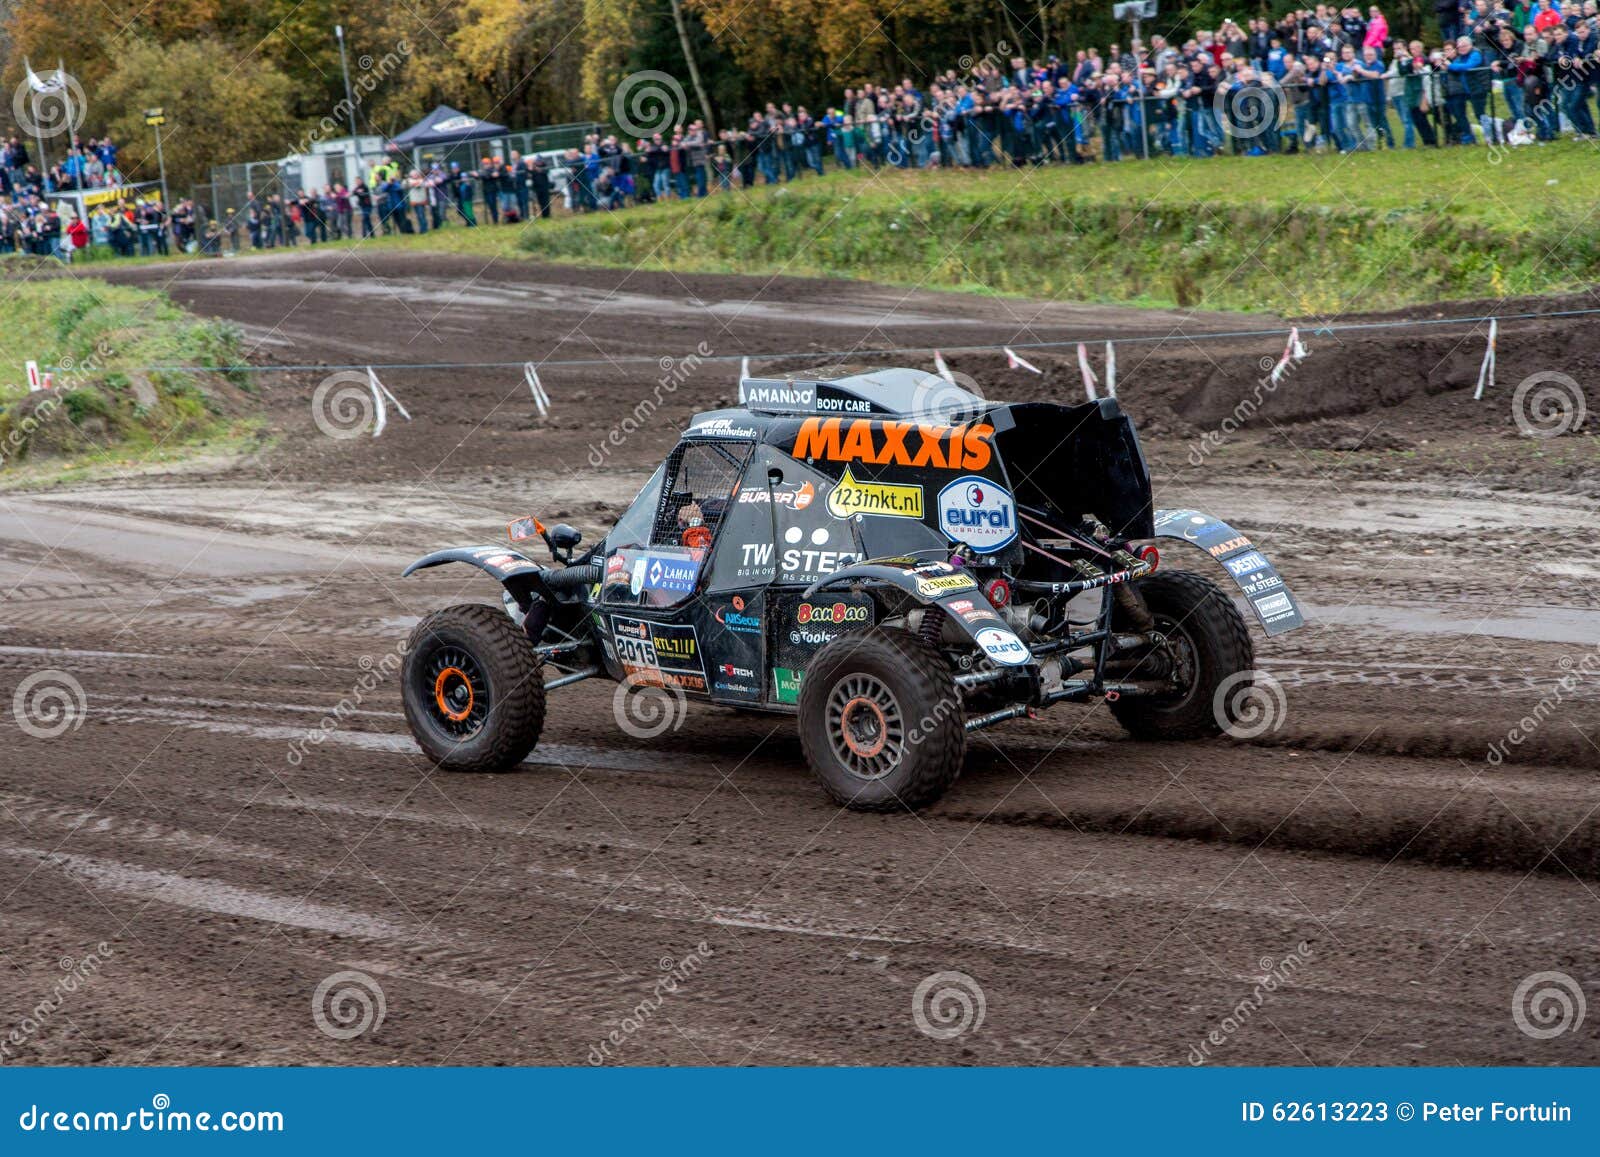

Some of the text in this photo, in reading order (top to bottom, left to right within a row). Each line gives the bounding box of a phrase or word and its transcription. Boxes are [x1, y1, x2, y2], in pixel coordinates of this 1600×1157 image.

[749, 388, 813, 404] AMANDO
[817, 398, 871, 412] BODY CARE
[792, 417, 995, 471] MAXXIS
[739, 491, 794, 503] SUPER
[834, 487, 920, 512] 123inkt.nl
[946, 504, 1009, 528] eurol
[742, 544, 773, 566] TW
[664, 566, 695, 580] LAMAN
[920, 576, 972, 593] 123inkt.nl
[1242, 584, 1257, 594] TW
[1257, 576, 1282, 590] STEEL
[798, 603, 868, 623] BanBao
[617, 638, 657, 665] 2015
[986, 640, 1023, 653] eurol
